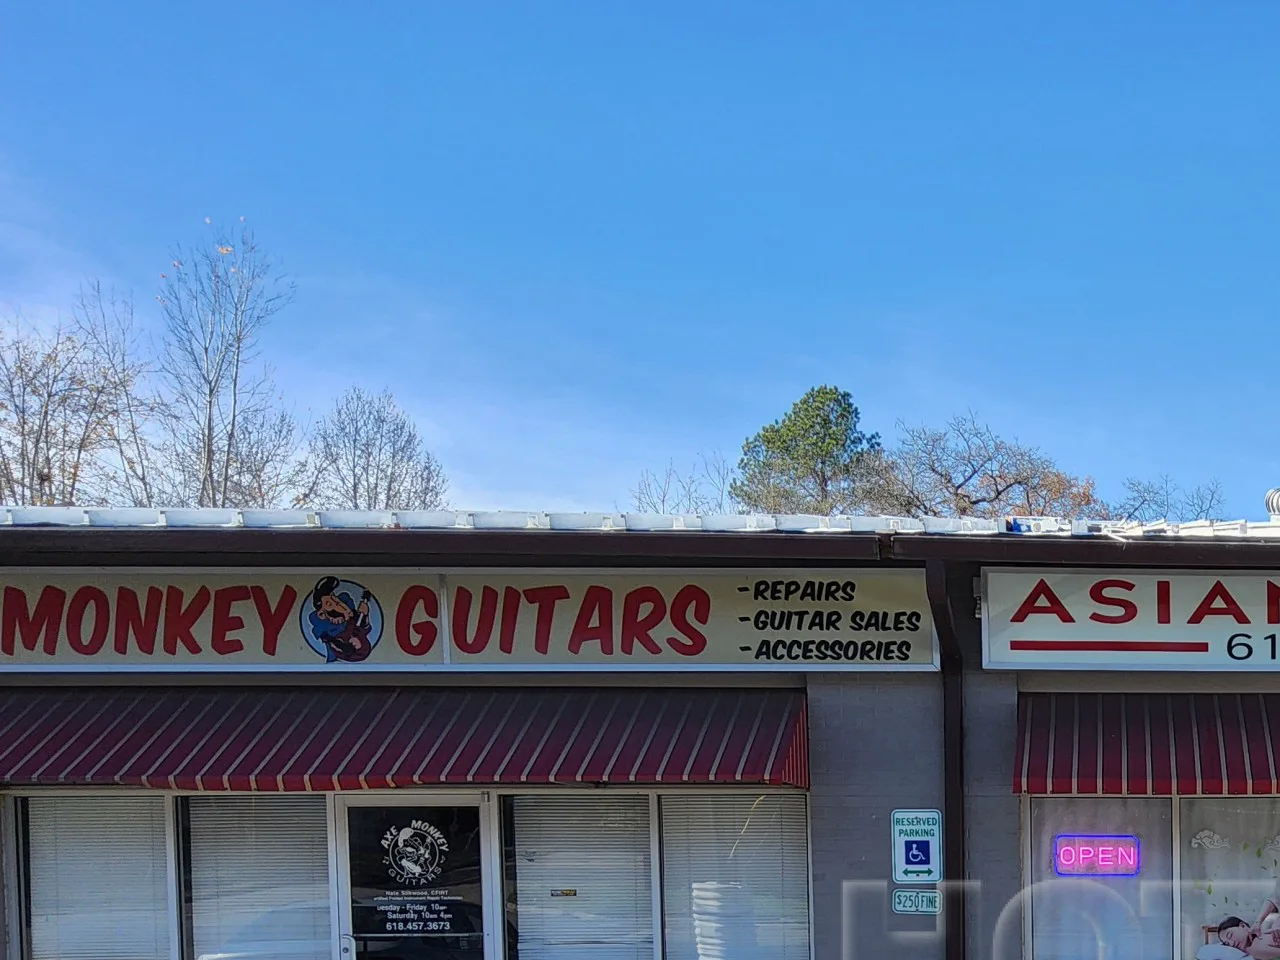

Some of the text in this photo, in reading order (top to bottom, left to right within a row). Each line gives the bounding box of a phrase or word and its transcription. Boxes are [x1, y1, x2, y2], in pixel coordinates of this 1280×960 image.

[1, 584, 711, 657] MONKEY GUITARS
[849, 611, 922, 631] SALES
[895, 817, 938, 826] RESERVED
[381, 819, 450, 852] AXE MONKEY
[898, 828, 935, 838] PARKING
[1060, 845, 1135, 866] OPEN
[388, 866, 442, 886] GUITARS
[406, 903, 427, 912] Friday
[896, 894, 938, 909] $250 FINE
[387, 911, 418, 920] Saturday
[386, 922, 450, 931] 618.457.3673
